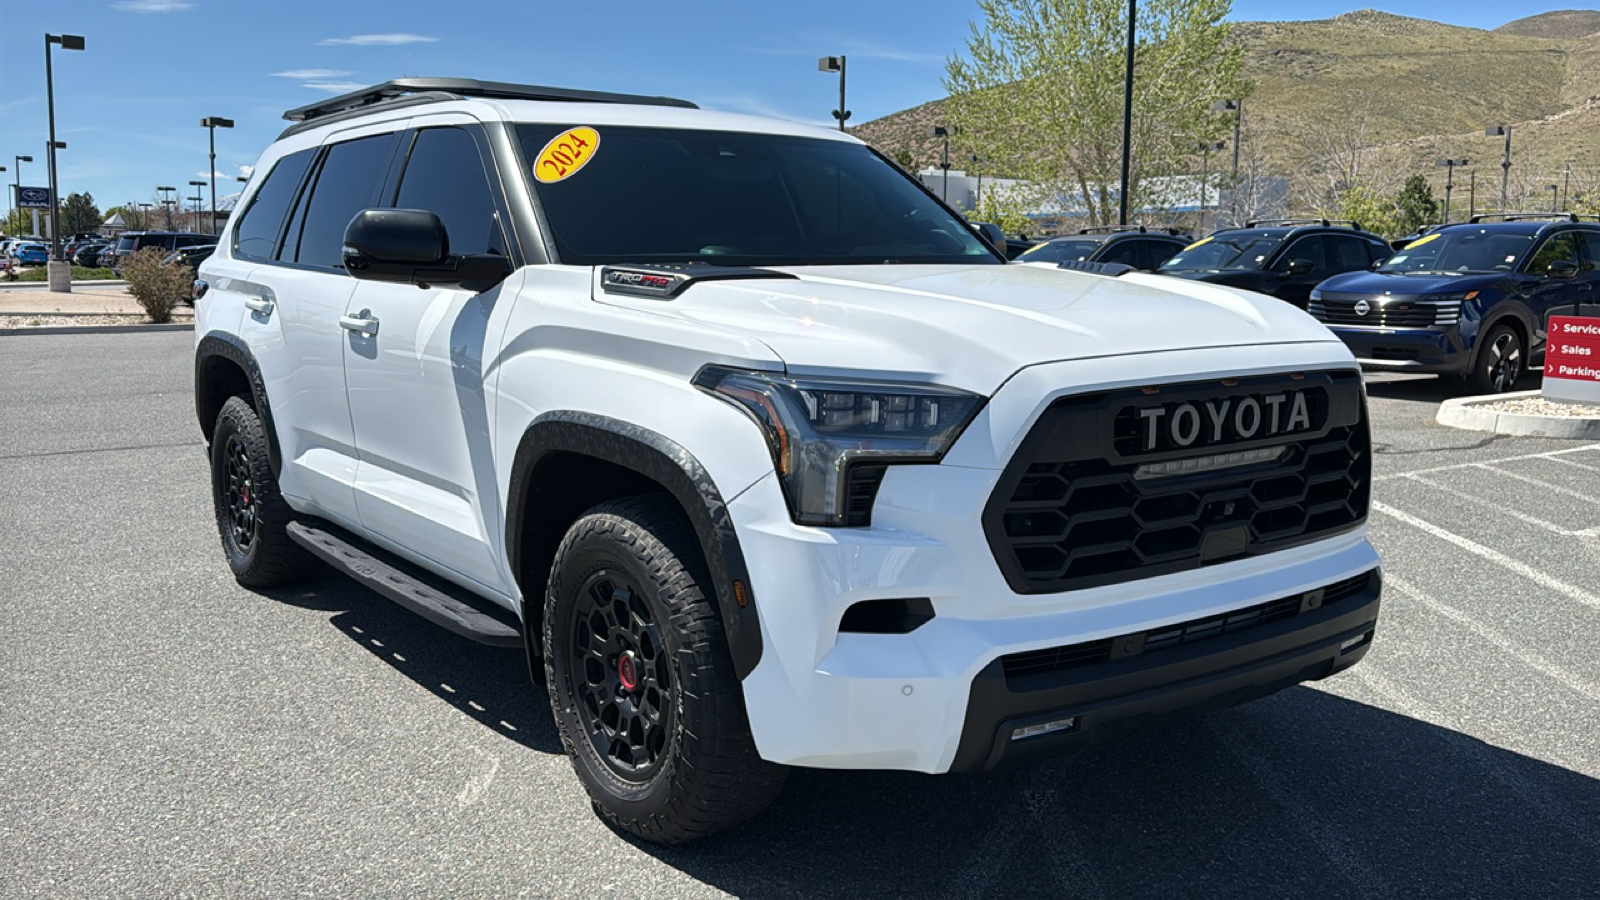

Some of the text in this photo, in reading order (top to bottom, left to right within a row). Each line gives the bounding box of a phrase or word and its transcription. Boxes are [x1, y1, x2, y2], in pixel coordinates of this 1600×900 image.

[543, 133, 589, 177] 2024
[1561, 344, 1591, 356] Sales
[1559, 365, 1600, 380] Parking
[1140, 391, 1310, 450] TOYOTA
